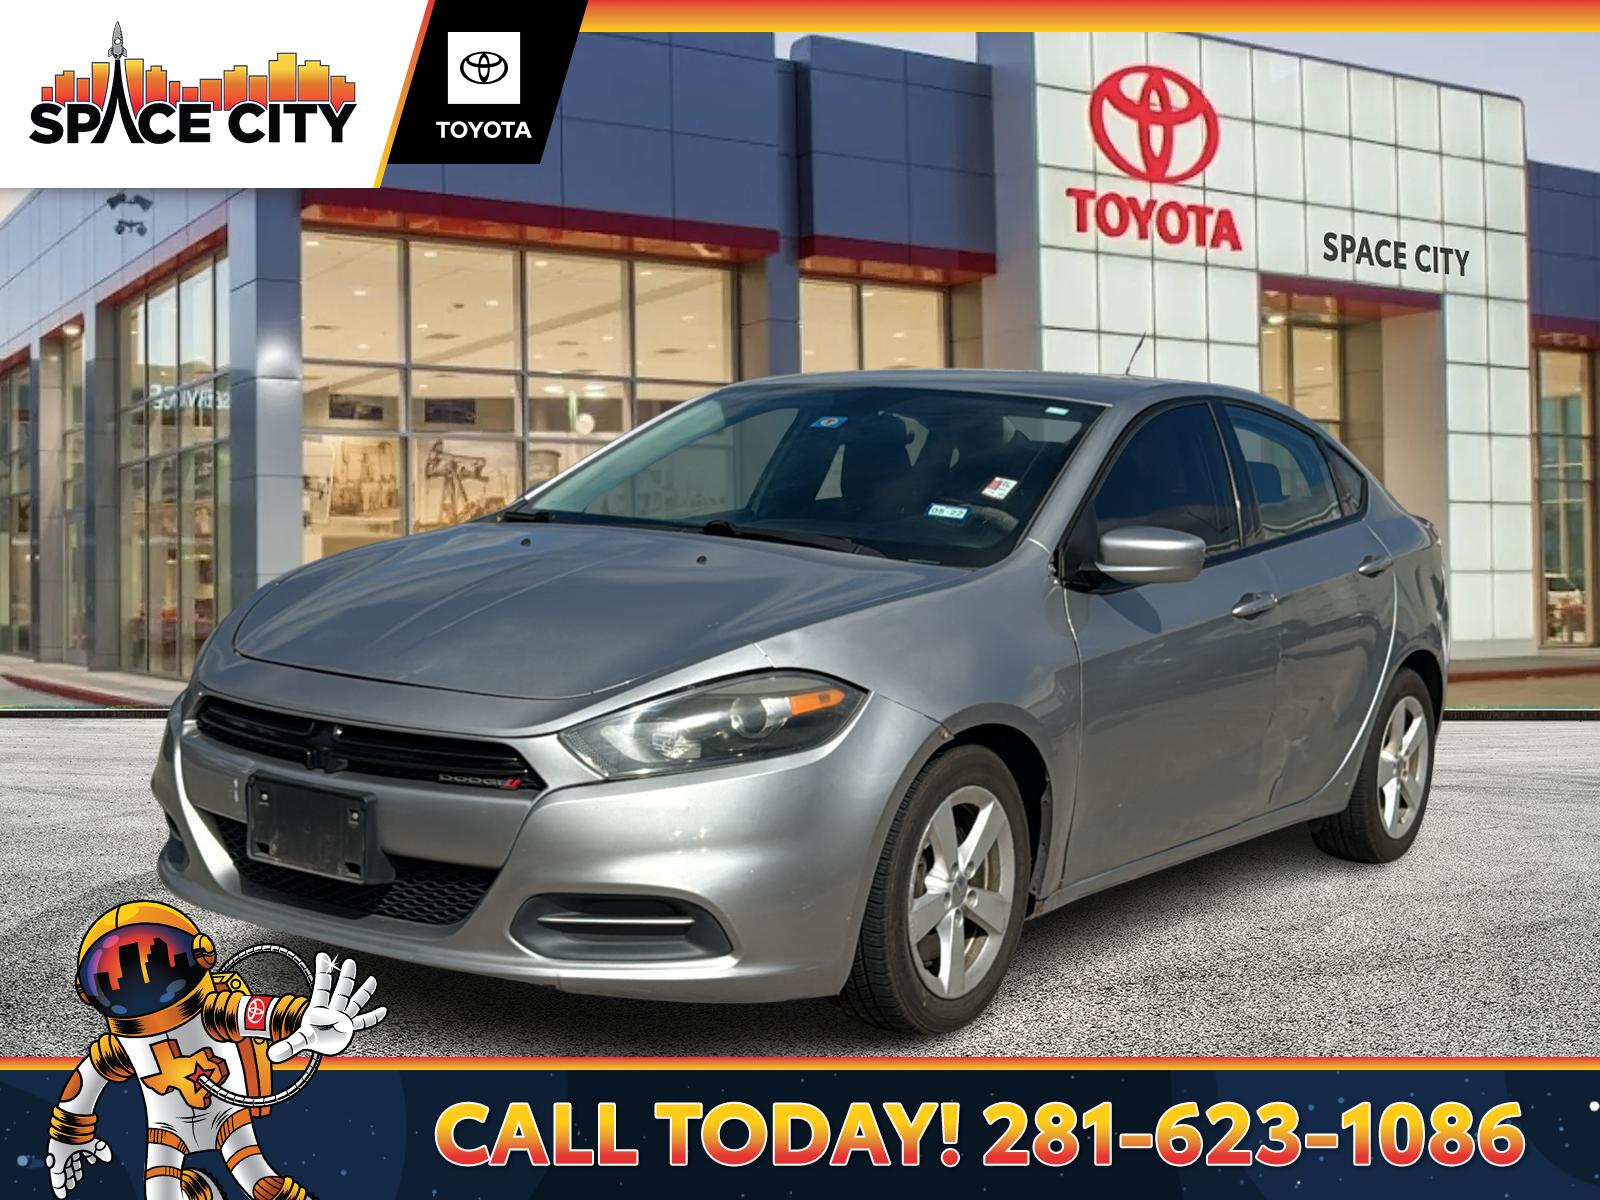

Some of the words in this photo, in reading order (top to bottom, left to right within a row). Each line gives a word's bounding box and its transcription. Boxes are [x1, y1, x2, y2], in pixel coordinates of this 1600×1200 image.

[1066, 188, 1242, 251] TOYOTA
[1323, 231, 1407, 270] SPACE
[1414, 243, 1470, 277] CITY
